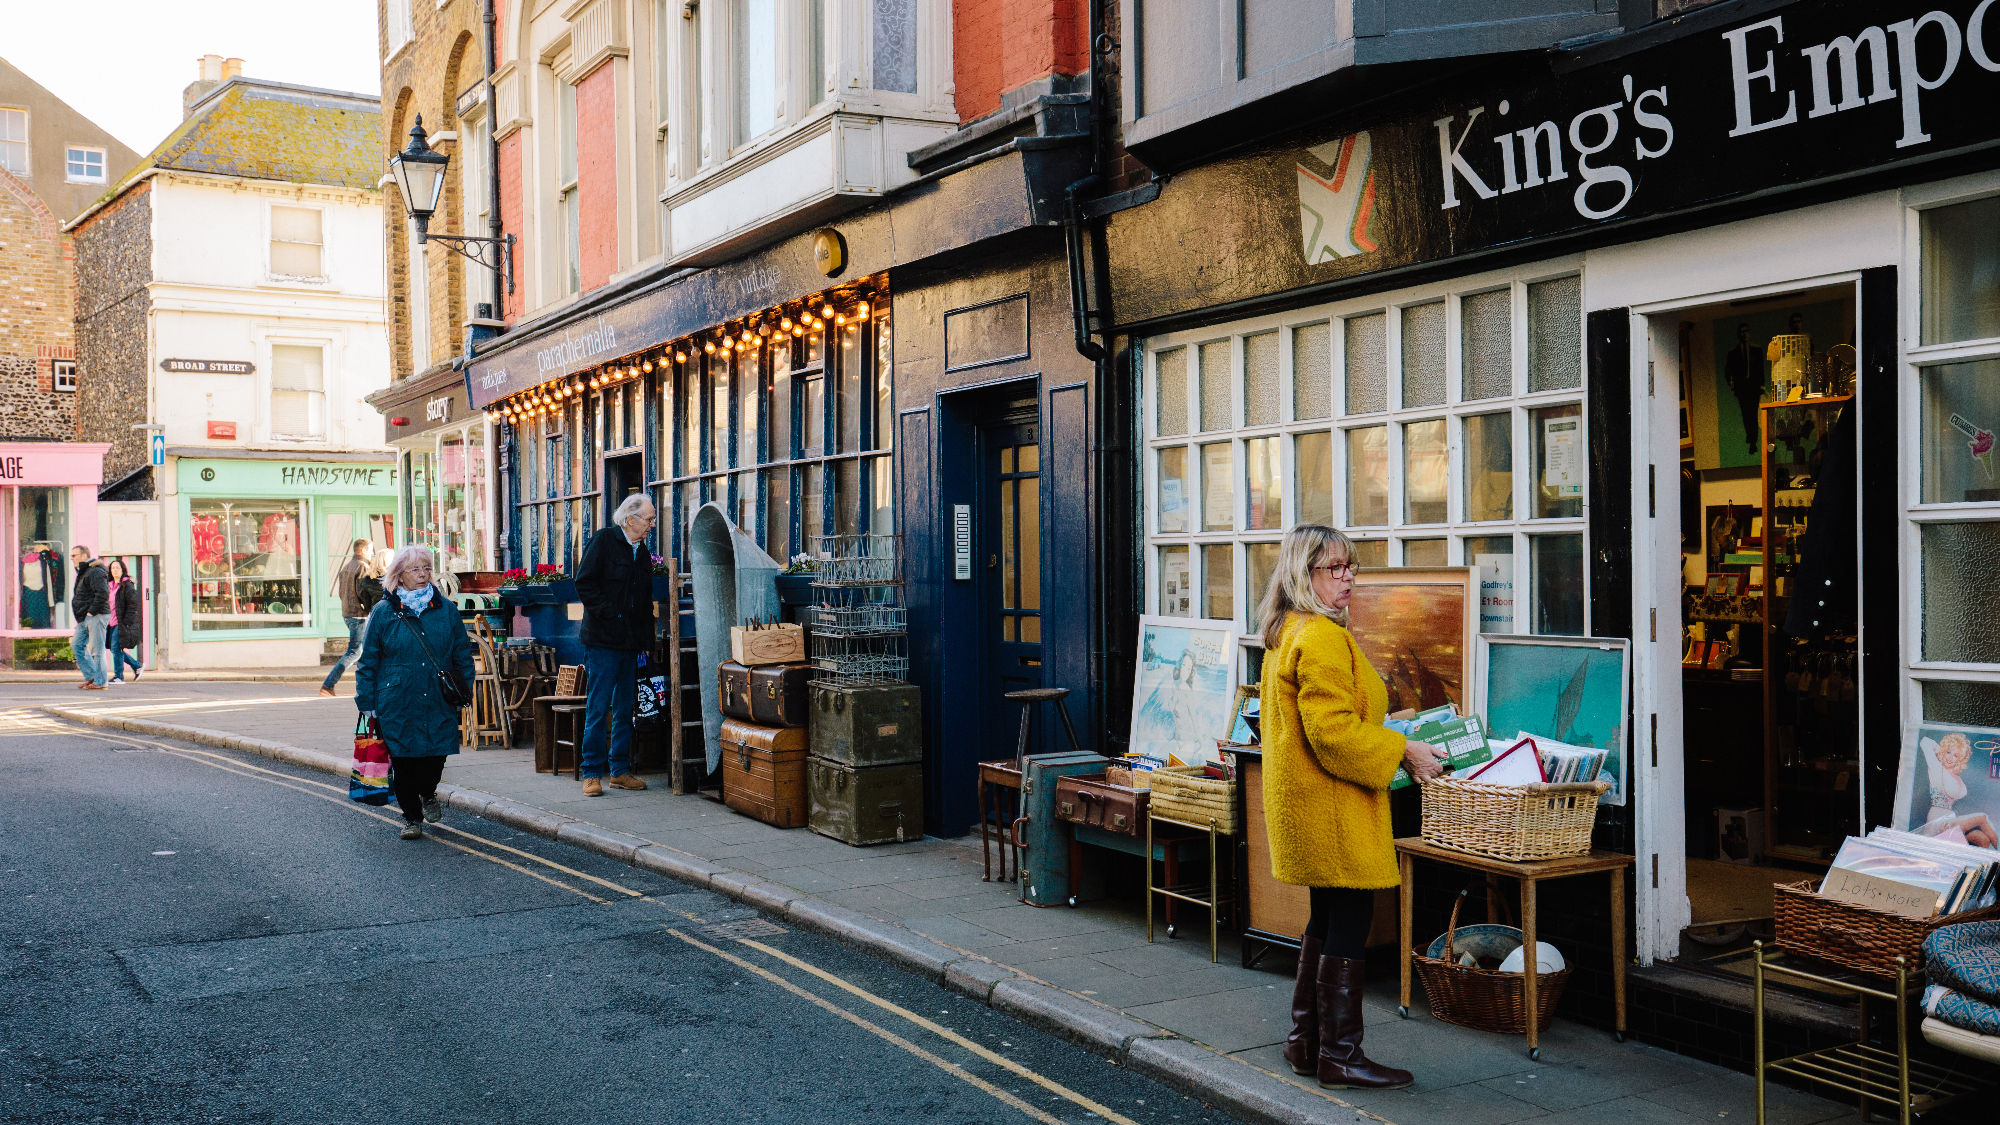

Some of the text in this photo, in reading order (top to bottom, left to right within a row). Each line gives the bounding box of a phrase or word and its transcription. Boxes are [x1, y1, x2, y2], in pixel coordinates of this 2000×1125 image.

[1433, 75, 1674, 219] King's
[739, 262, 781, 294] vintage
[537, 314, 617, 383] paraphernalia
[170, 361, 246, 372] BROAD STREET
[426, 396, 449, 423] story
[282, 466, 384, 487] HANDSOME
[1481, 580, 1513, 590] Godfrey's
[1481, 597, 1490, 606] £1
[1197, 649, 1217, 666] GIRL
